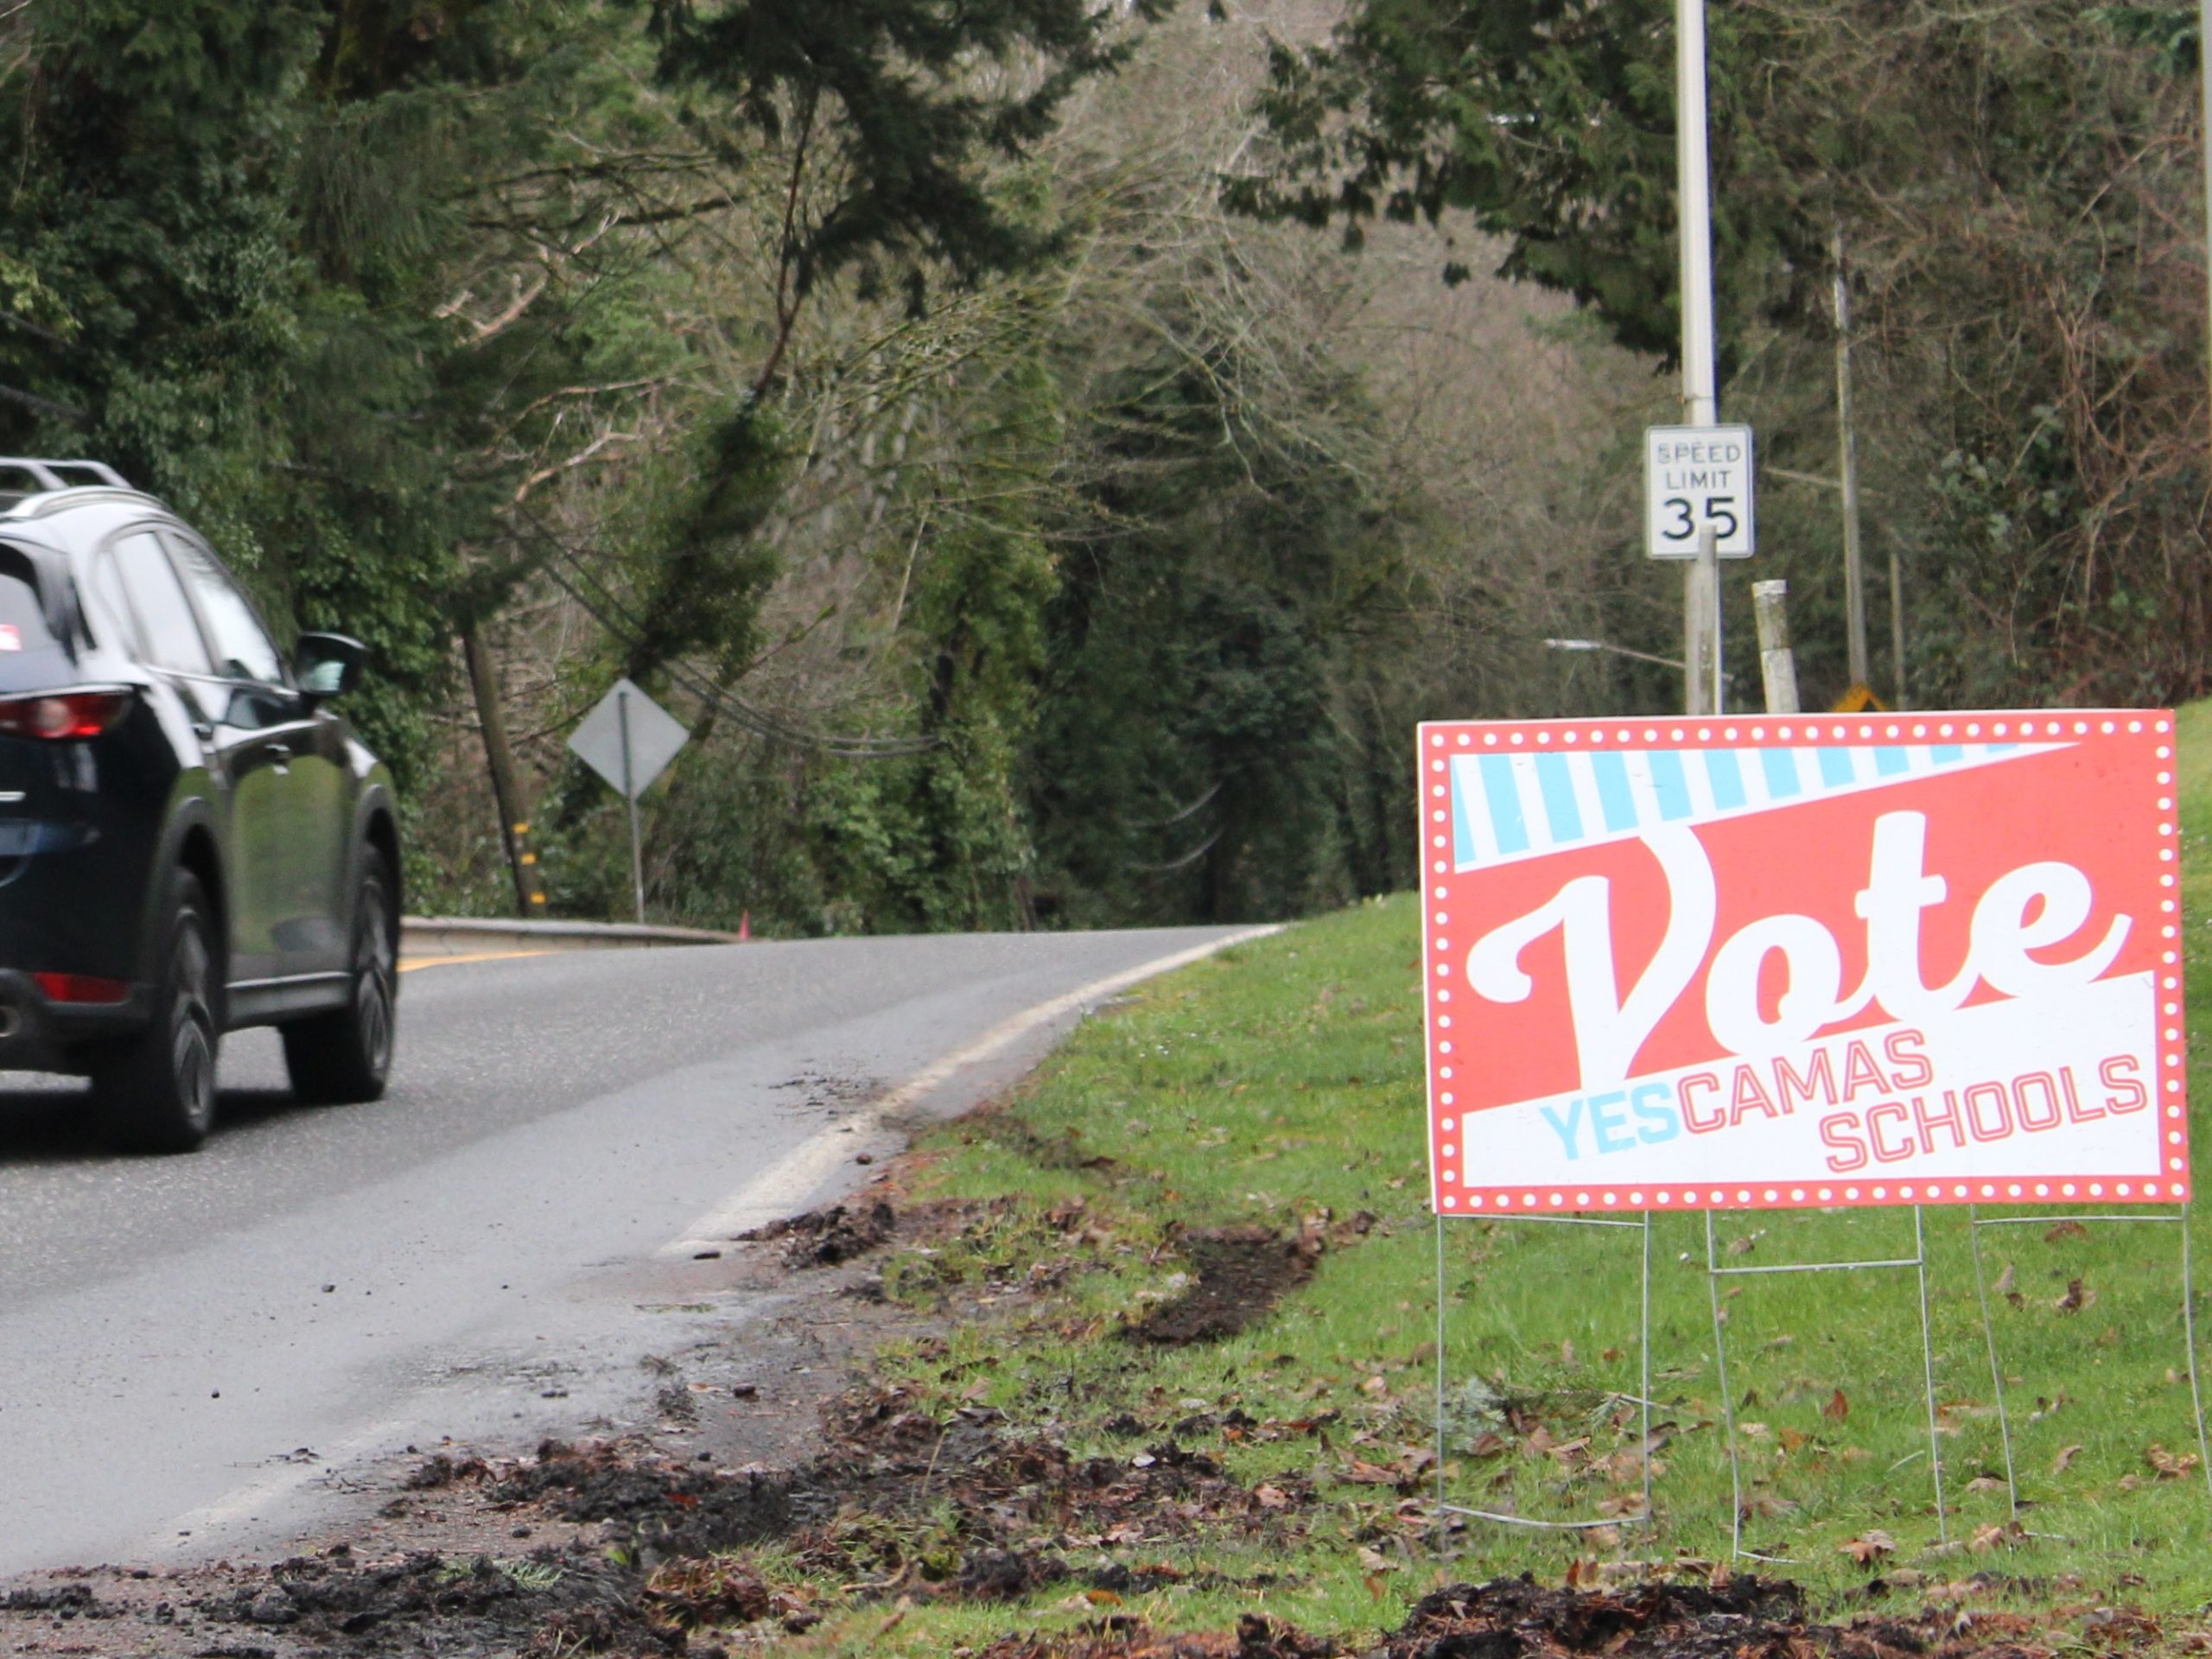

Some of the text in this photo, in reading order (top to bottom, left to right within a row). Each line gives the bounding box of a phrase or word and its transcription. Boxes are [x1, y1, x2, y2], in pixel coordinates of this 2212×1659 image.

[1657, 442, 1741, 464] SPEED
[1666, 470, 1732, 490] LIMIT
[1662, 496, 1737, 540] 35
[1465, 810, 2133, 1090] Vote
[1819, 1053, 2148, 1173] SCHOOLS
